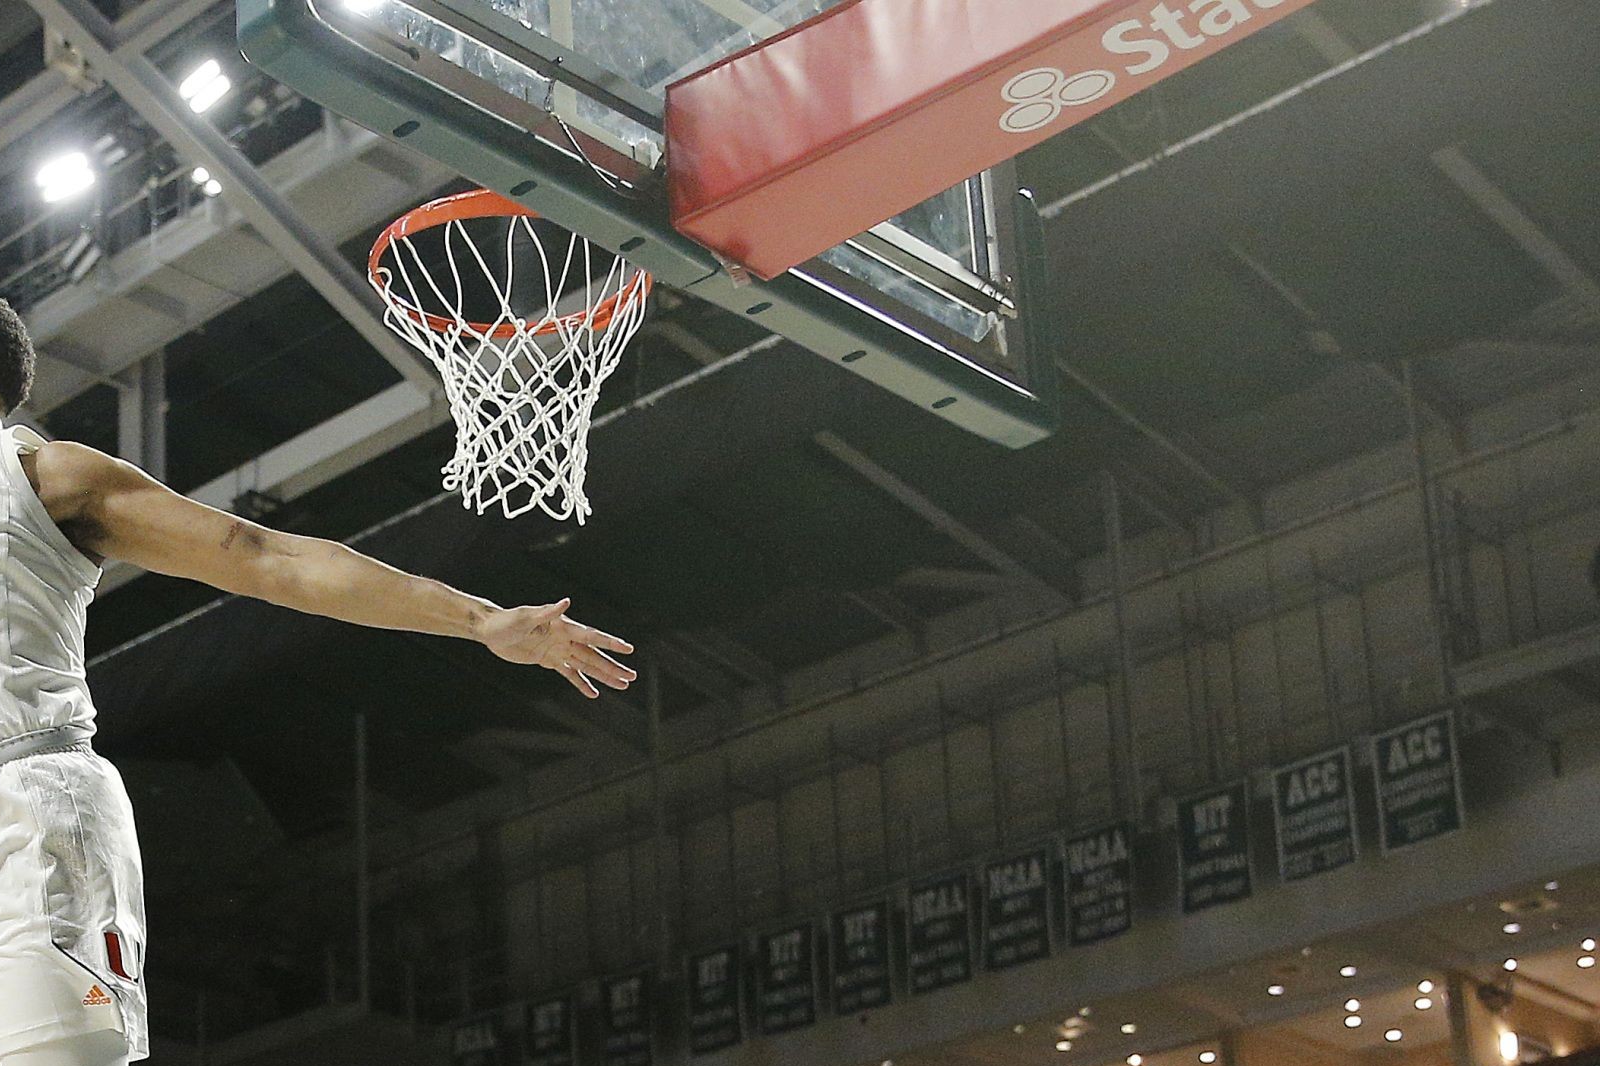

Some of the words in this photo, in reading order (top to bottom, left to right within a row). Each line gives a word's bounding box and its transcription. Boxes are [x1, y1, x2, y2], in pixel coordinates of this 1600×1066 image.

[1102, 0, 1287, 75] Sta
[1387, 726, 1442, 773] ACC
[1286, 762, 1339, 807] ACC
